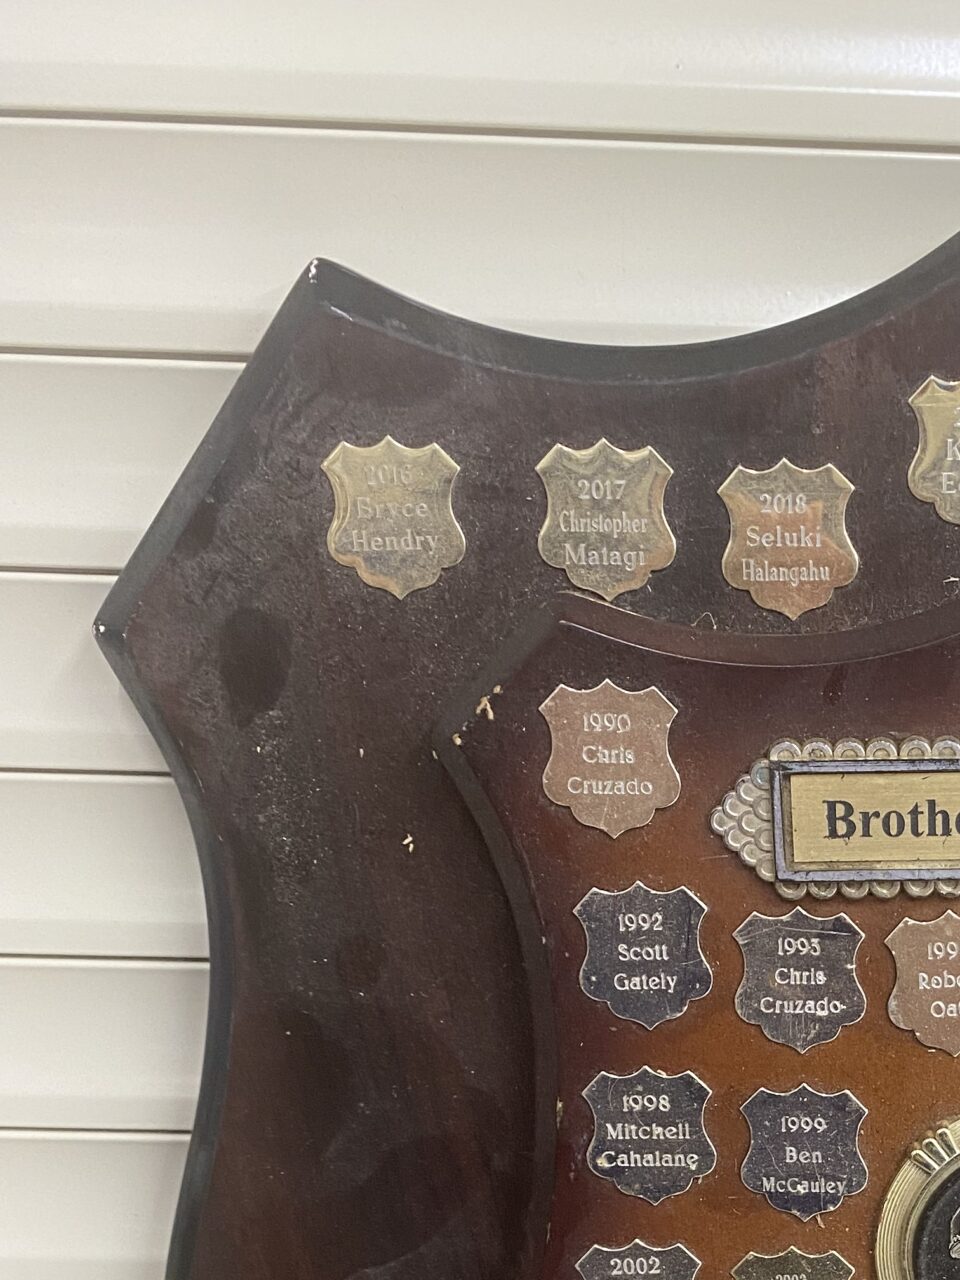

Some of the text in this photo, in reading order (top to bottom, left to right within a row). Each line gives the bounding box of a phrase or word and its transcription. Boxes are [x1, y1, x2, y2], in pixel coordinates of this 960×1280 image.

[577, 479, 626, 500] 2017
[357, 497, 428, 520] Bryce
[759, 493, 807, 514] 2018
[559, 510, 648, 539] Christopher
[352, 529, 438, 554] Hendry
[746, 526, 822, 547] Seluki
[565, 544, 647, 571] Matagi
[741, 558, 831, 586] Halangahu
[581, 712, 632, 733] 1990
[581, 745, 635, 765] Chris
[566, 776, 653, 796] Cruzado
[617, 913, 664, 932] 1992
[617, 943, 669, 961] Scott
[776, 937, 821, 955] 1993
[613, 973, 677, 993] Gately
[774, 968, 827, 985] Chris
[759, 997, 842, 1016] Cruzado
[622, 1094, 671, 1112] 1998
[606, 1123, 690, 1140] Mitchell
[781, 1116, 827, 1133] 1999
[601, 1151, 699, 1168] Cahalane
[785, 1147, 823, 1164] Ben
[610, 1257, 661, 1276] 2002
